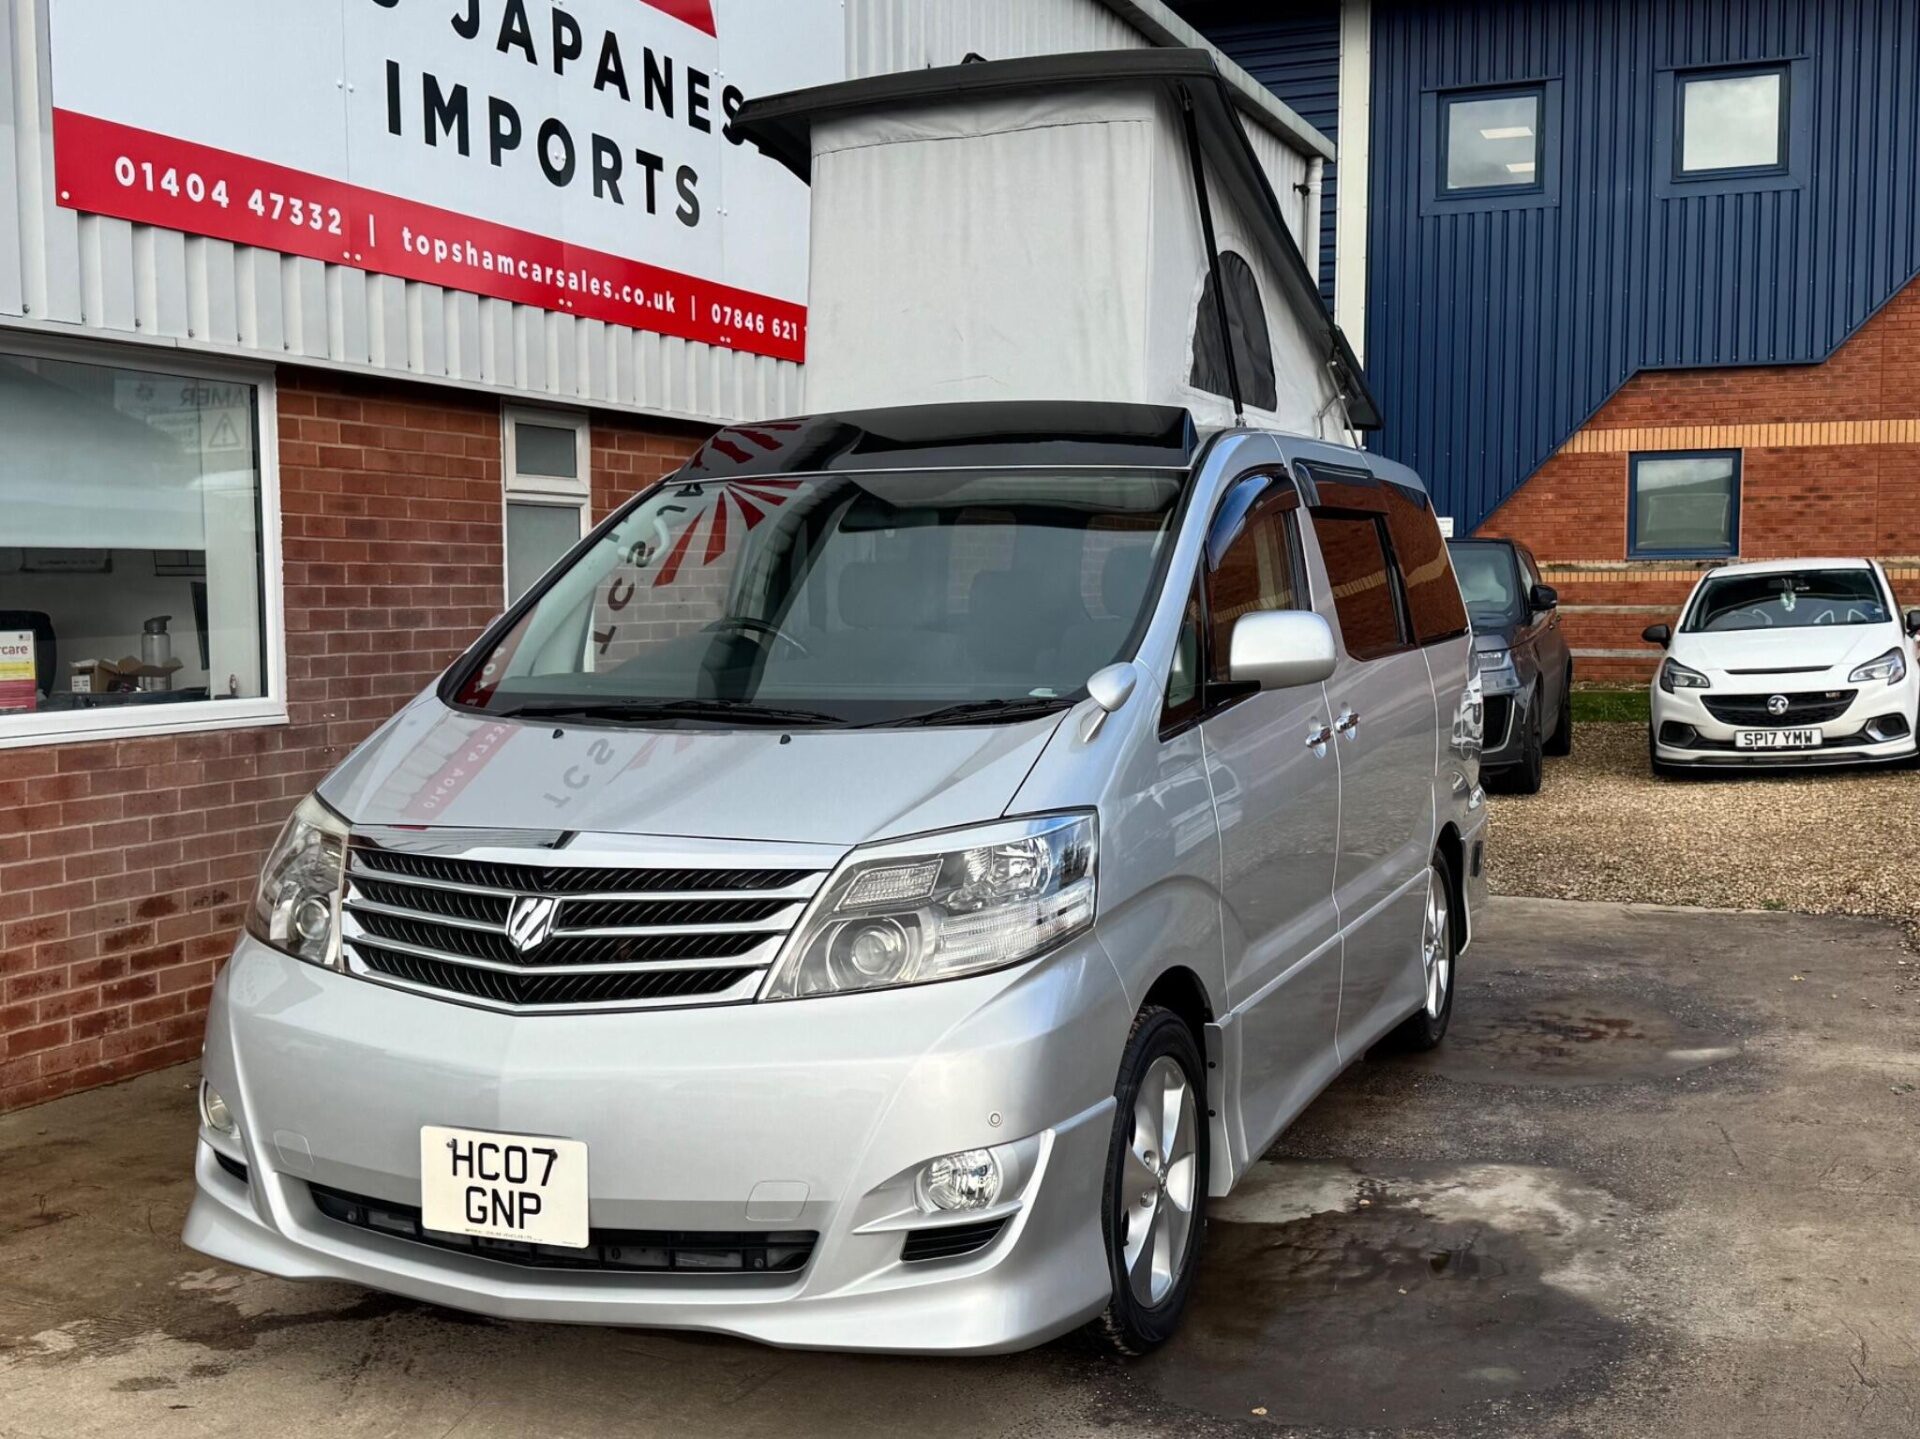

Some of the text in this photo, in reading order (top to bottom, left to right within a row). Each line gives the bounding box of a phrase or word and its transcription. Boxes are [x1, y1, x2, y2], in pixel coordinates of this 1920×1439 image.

[386, 59, 700, 228] IMPORTS
[114, 156, 798, 342] 01404 47332 topshamcarsales.co.uk 07846 621
[0, 645, 28, 655] care
[1744, 731, 1813, 746] SP17 YMW
[452, 1138, 556, 1187] HC07
[465, 1186, 542, 1229] GNP
